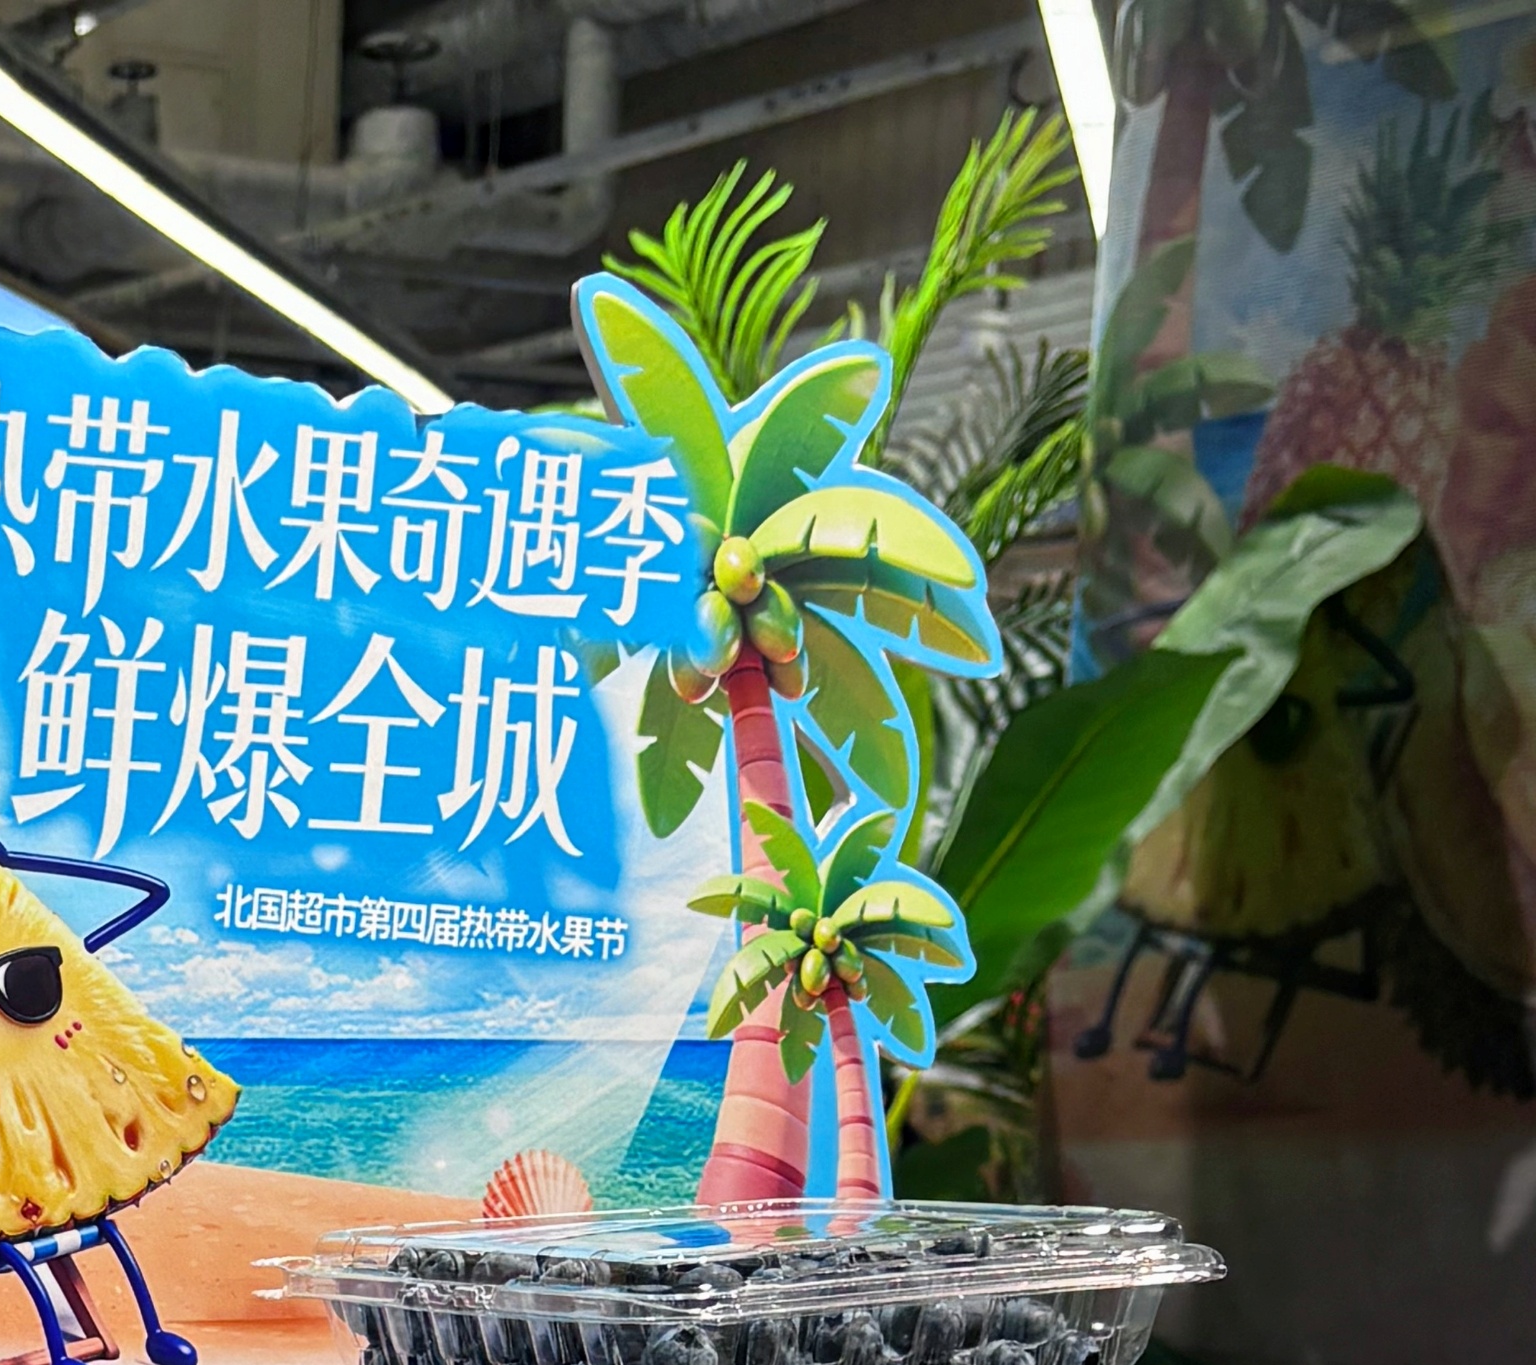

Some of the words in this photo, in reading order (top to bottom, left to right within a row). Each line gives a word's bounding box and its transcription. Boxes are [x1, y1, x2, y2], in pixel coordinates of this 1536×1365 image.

[12, 609, 583, 861] 鲜爆全城
[214, 885, 628, 960] 北国超市第四届热带水果节
